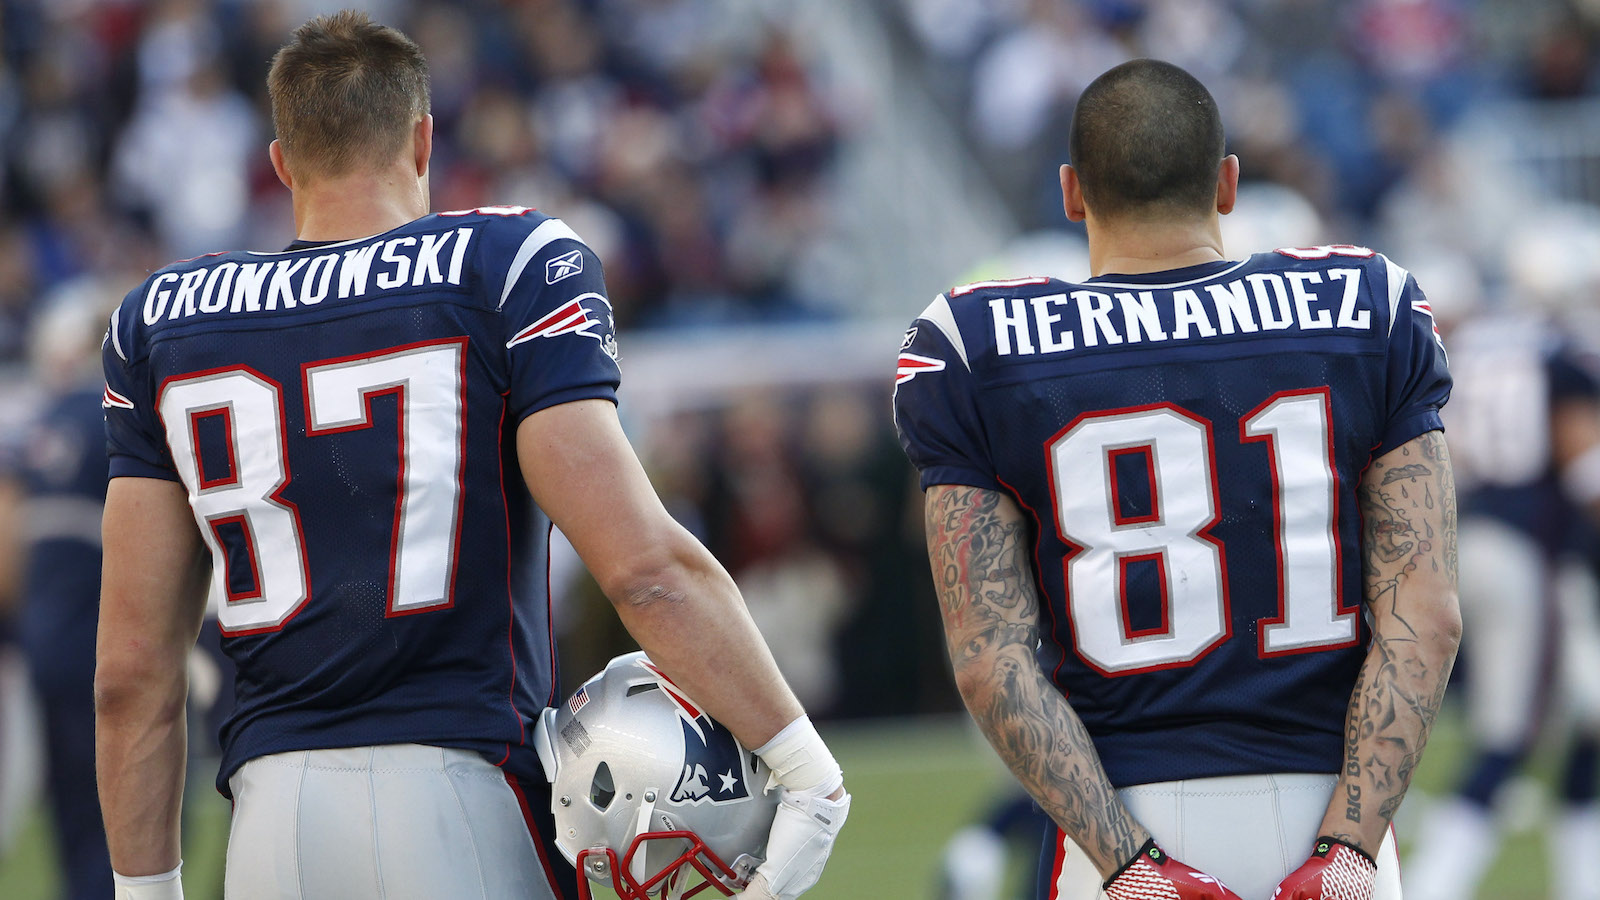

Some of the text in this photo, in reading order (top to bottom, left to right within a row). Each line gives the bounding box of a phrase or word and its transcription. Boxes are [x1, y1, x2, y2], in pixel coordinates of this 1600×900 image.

[142, 227, 473, 327] GRONKOWSKI
[988, 267, 1371, 356] HERNANDEZ
[155, 335, 469, 638] 87
[1043, 384, 1361, 678] 81
[1347, 663, 1369, 779] BROTHER
[1346, 784, 1361, 823] BIG
